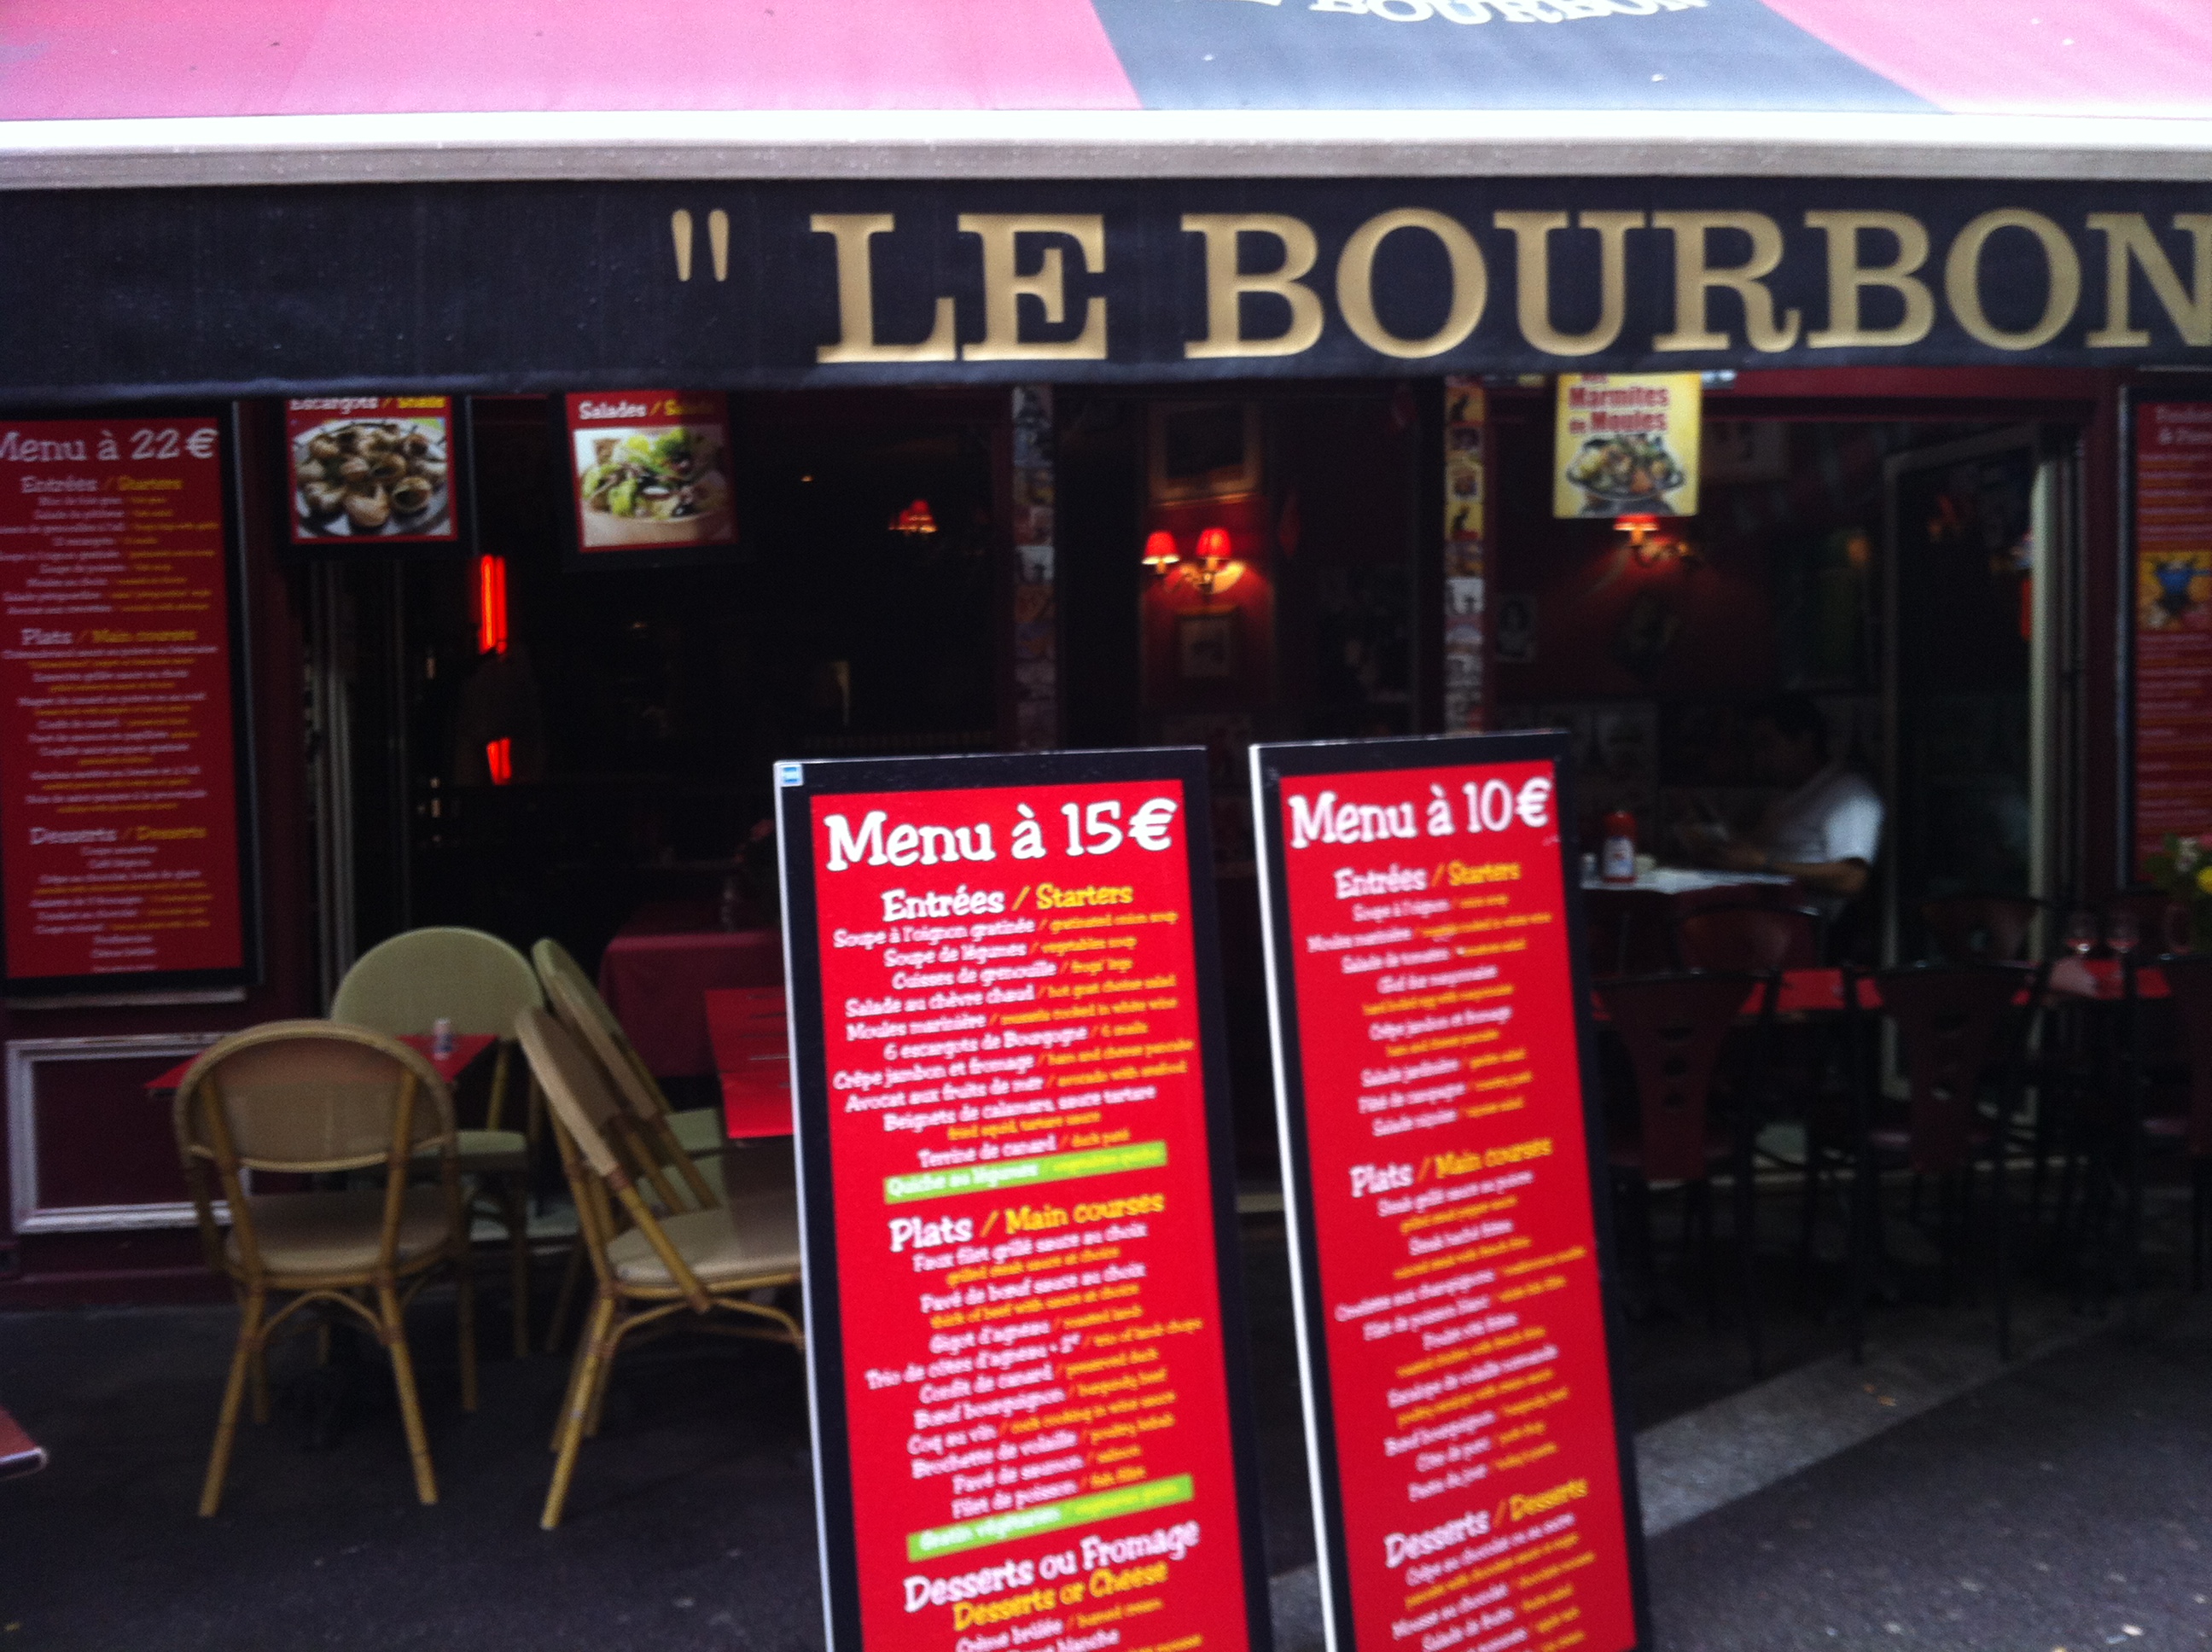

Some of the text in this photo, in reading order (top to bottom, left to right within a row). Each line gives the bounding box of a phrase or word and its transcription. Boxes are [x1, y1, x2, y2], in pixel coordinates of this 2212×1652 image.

[810, 213, 1108, 364] LE
[1180, 206, 2212, 362] BOURBON
[579, 400, 647, 419] Salades
[1569, 386, 1669, 408] Marmites
[97, 430, 120, 461] à
[130, 428, 218, 460] 22€
[1288, 777, 1552, 849] Menu à 10€
[824, 797, 1179, 872] Menu à 15€
[1333, 863, 1428, 900] Entrées
[1447, 859, 1522, 887] Starters
[881, 885, 1006, 922] Entrées
[1035, 881, 1134, 910] Starters
[833, 928, 887, 950] Soupe
[883, 947, 937, 969] Soupe
[936, 945, 959, 962] de
[955, 966, 978, 983] de
[845, 996, 902, 1017] Salade
[883, 1042, 899, 1060] 6
[979, 1032, 1002, 1050] de
[977, 1142, 1000, 1160] de
[1348, 1162, 1415, 1198] Plats
[1435, 1151, 1484, 1178] Main
[1483, 1137, 1553, 1168] courses
[887, 1215, 975, 1253] Plats
[1004, 1202, 1070, 1234] Main
[1072, 1192, 1166, 1224] courses
[1383, 1509, 1490, 1569] Desserts
[902, 1521, 1201, 1612] Desserts ou Fromage
[953, 1561, 1169, 1631] Desserts or Cheese
